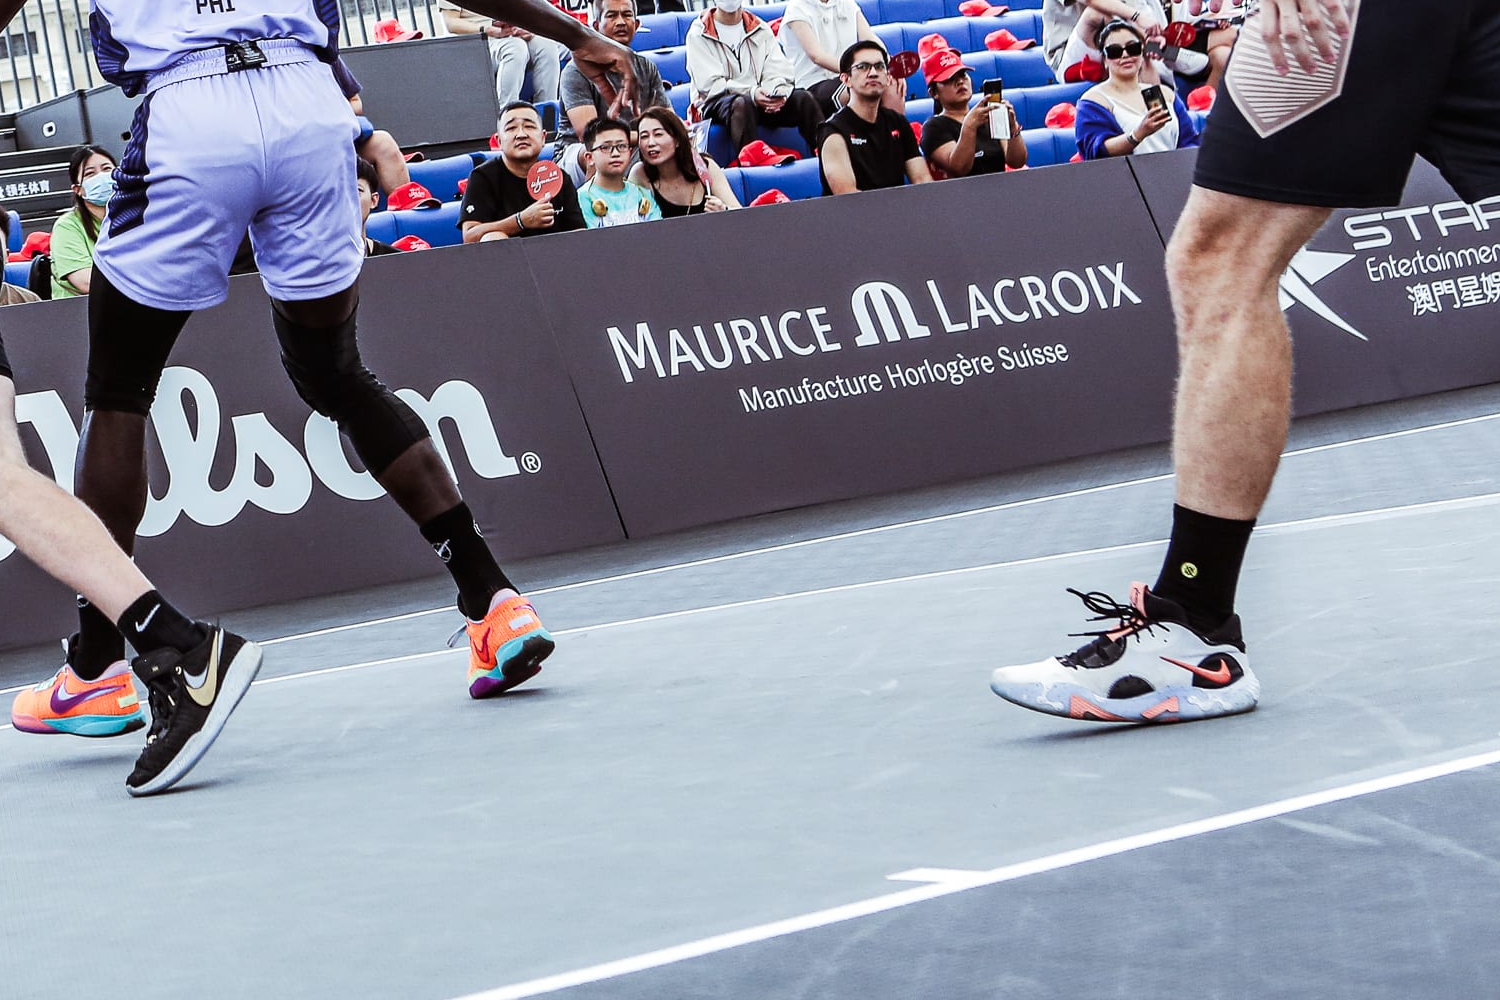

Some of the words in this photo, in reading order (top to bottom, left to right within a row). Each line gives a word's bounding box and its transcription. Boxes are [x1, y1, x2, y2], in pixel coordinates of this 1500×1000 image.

[927, 262, 1142, 334] LACROIX
[738, 373, 885, 413] Manufacture
[885, 351, 996, 390] Horlogère
[997, 341, 1070, 370] Suisse
